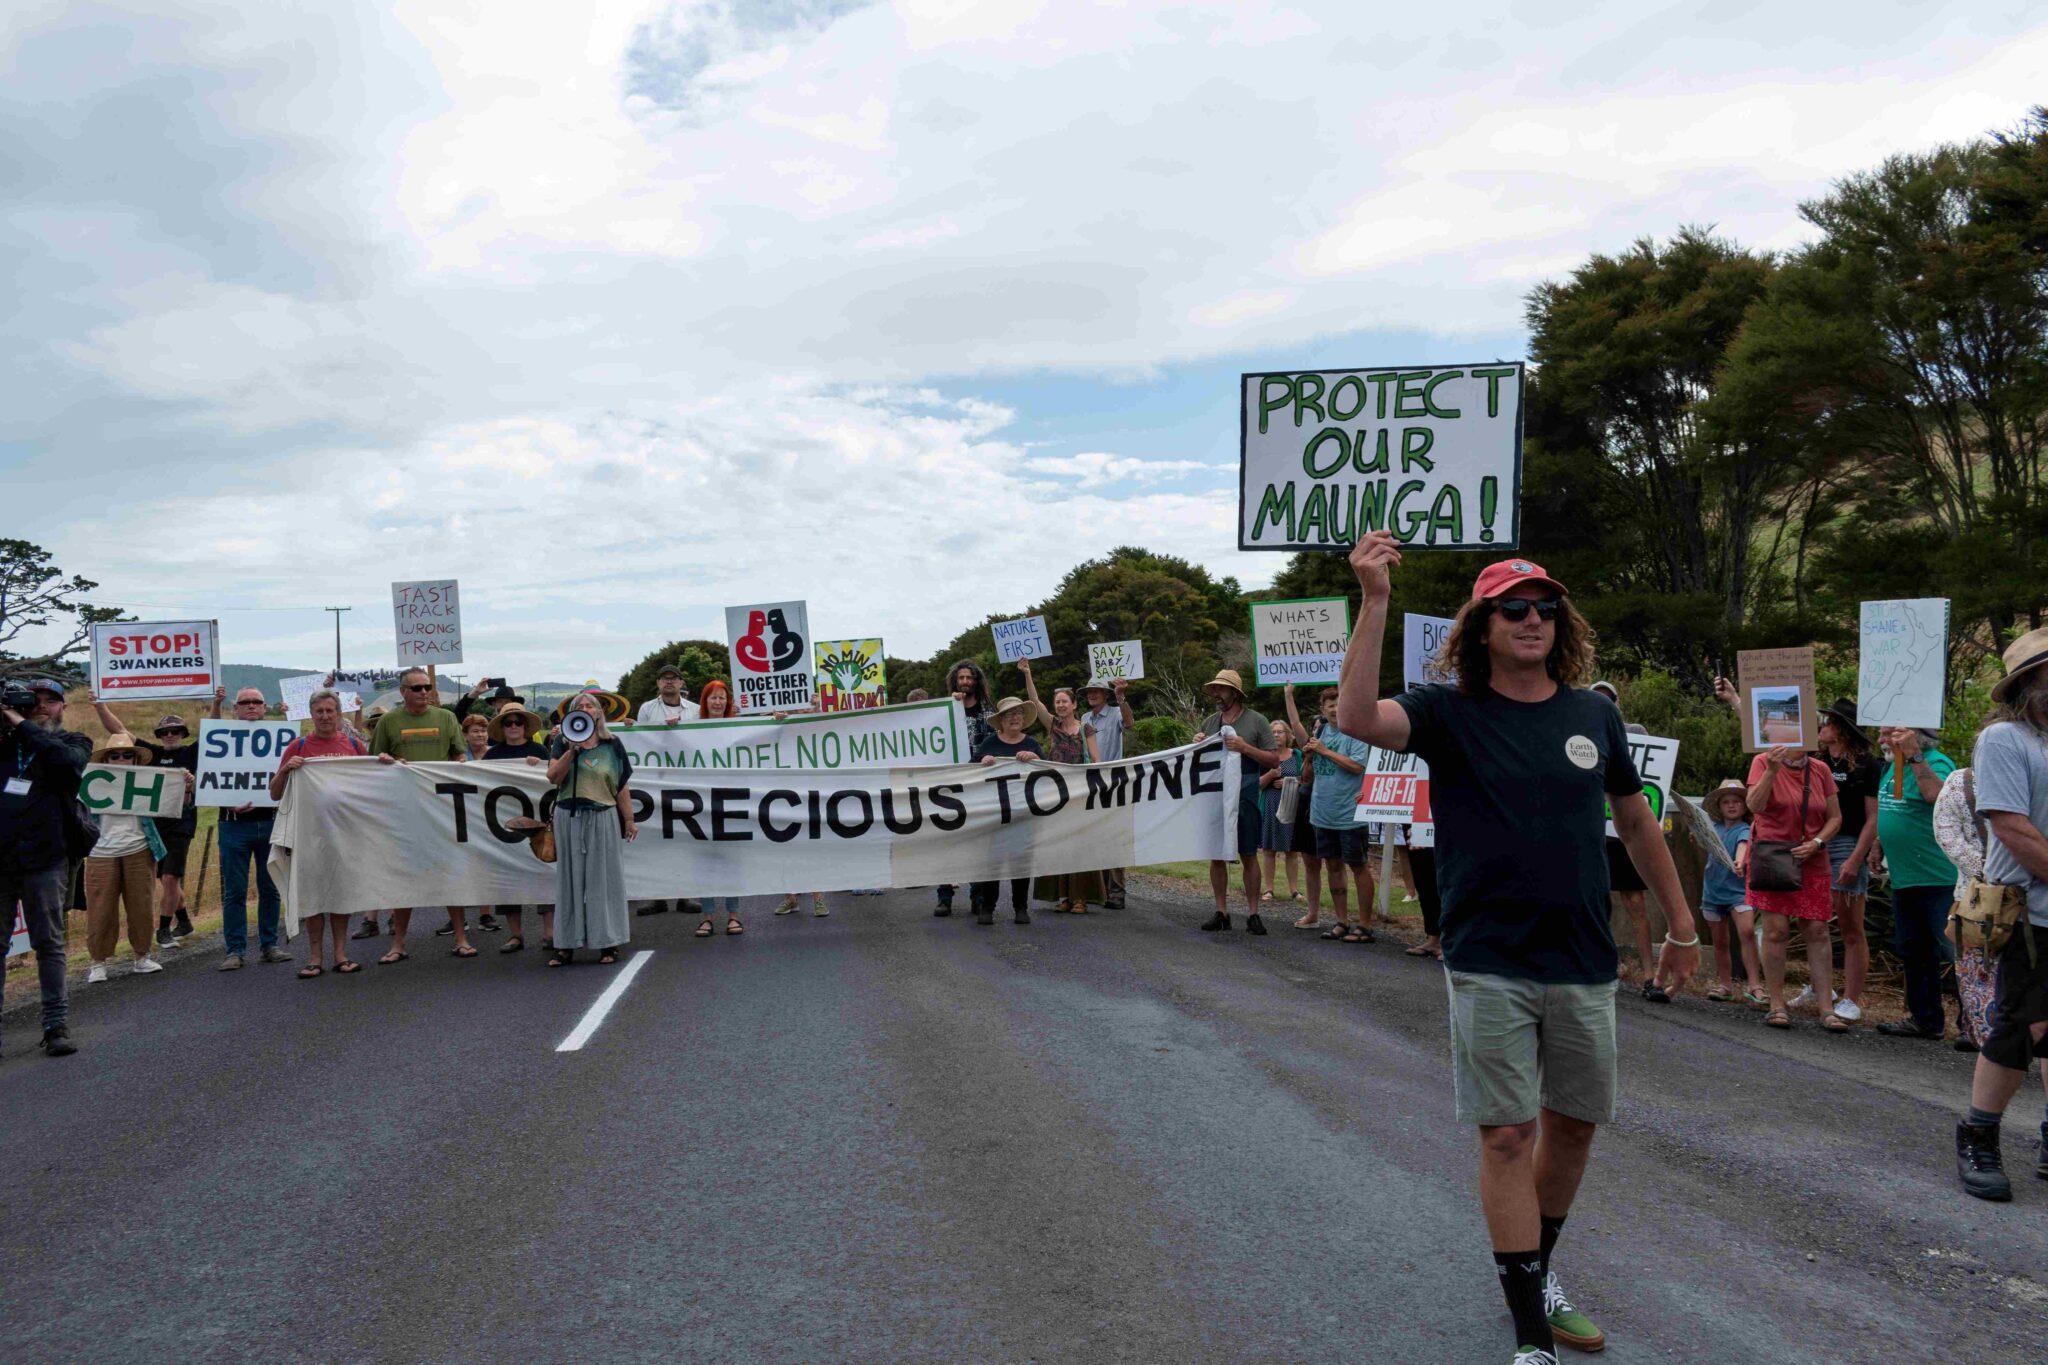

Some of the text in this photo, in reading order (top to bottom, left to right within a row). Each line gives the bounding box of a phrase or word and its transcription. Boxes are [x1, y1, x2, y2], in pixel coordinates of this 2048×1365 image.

[1258, 368, 1515, 434] PROTECT
[1303, 427, 1436, 479] OUR
[1251, 475, 1497, 544] MAUNGA!
[399, 586, 454, 603] FAST
[396, 604, 455, 619] TRACK
[1270, 607, 1331, 624] WHAT'S
[401, 623, 456, 635] WRONG
[994, 618, 1039, 640] NATURE
[1288, 628, 1317, 640] THE
[109, 633, 200, 655] STOP!
[400, 640, 461, 655] TRACK
[1003, 637, 1043, 658] FIRST
[1092, 645, 1125, 659] SAVE
[1869, 638, 1901, 656] WAR
[109, 657, 204, 670] 3WANKERS
[819, 649, 878, 680] NO MINES
[739, 673, 808, 692] TOGETHER
[741, 689, 809, 708] FOR TE TIRITI
[206, 728, 298, 758] STOP
[797, 731, 841, 768] NO
[849, 726, 946, 763] MINING
[1568, 742, 1593, 751] Earth
[1569, 750, 1596, 759] Watch
[621, 783, 967, 843] PRECIOUS
[985, 768, 1069, 824] TO
[1085, 742, 1223, 811] MINE
